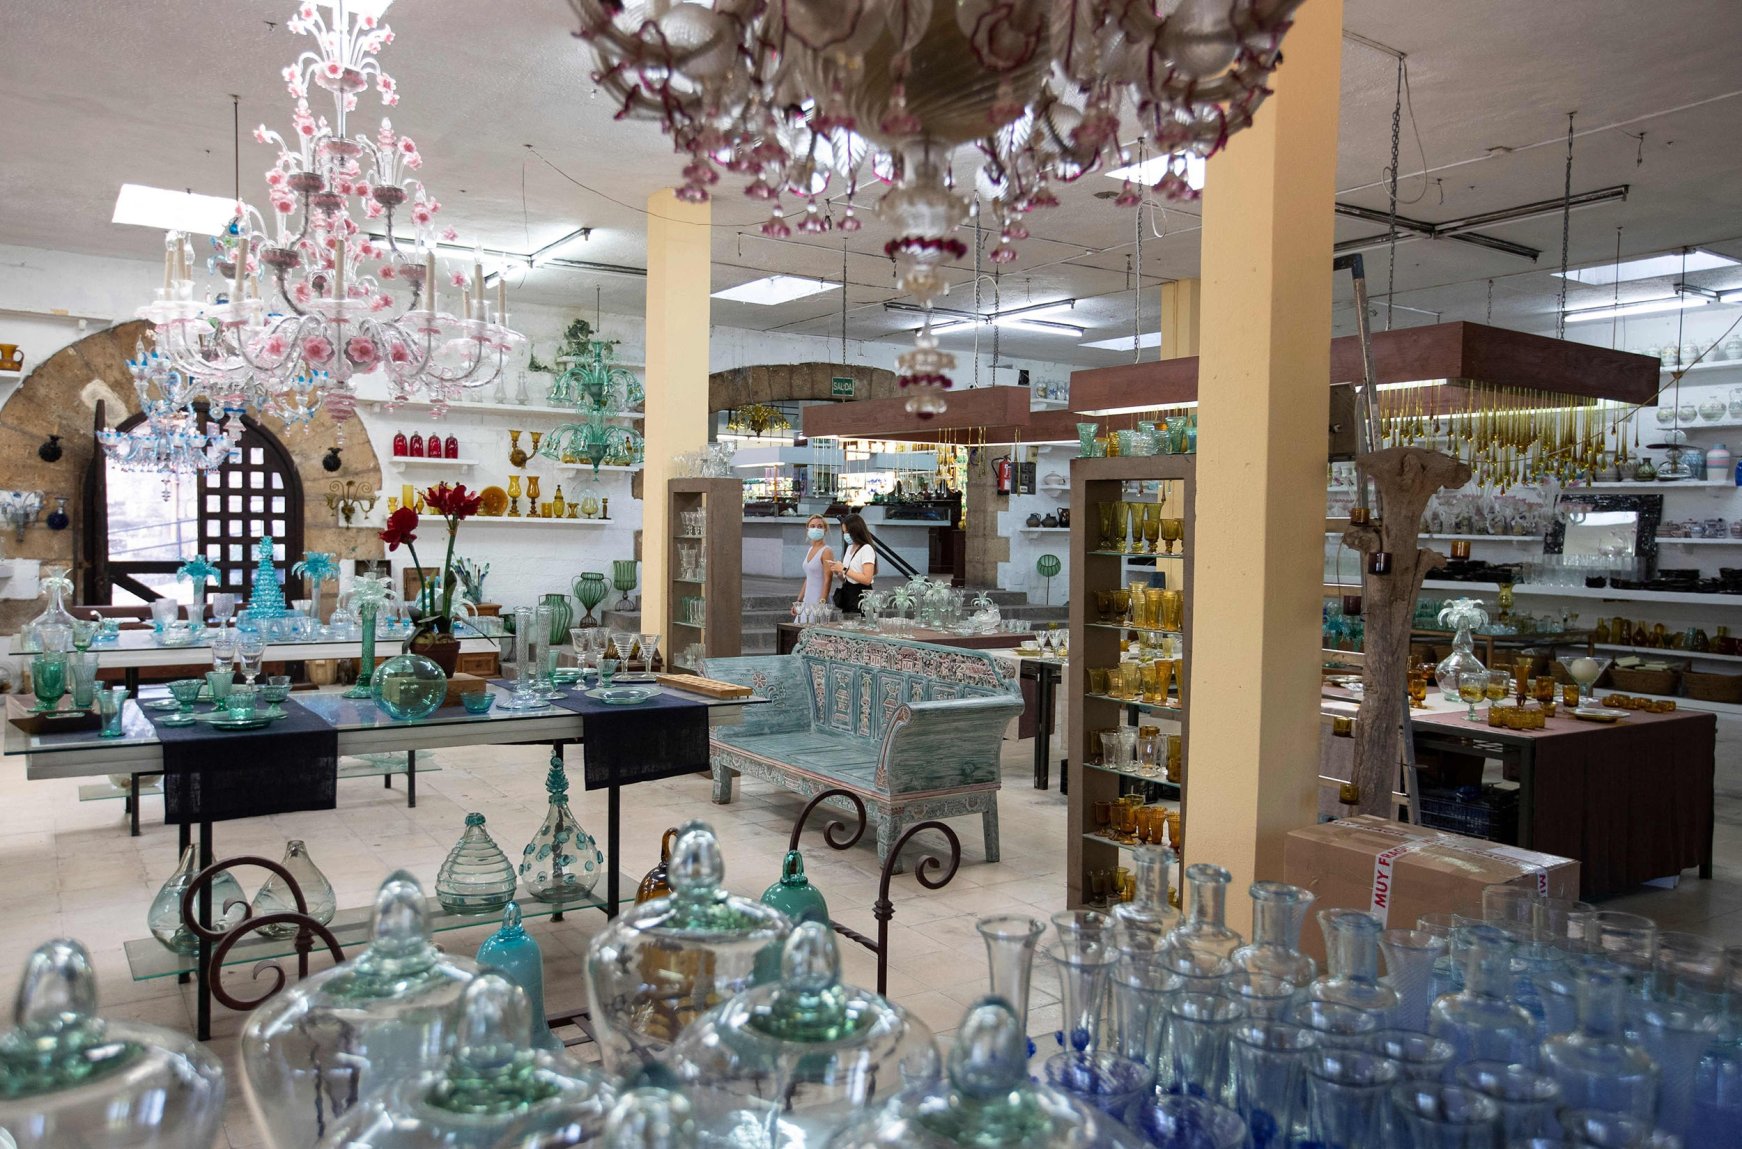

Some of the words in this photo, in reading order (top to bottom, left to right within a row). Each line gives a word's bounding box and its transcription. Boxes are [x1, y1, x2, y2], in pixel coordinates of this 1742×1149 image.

[833, 382, 853, 391] SALIDA
[1378, 845, 1409, 867] FRAG
[1374, 869, 1389, 909] MUY
